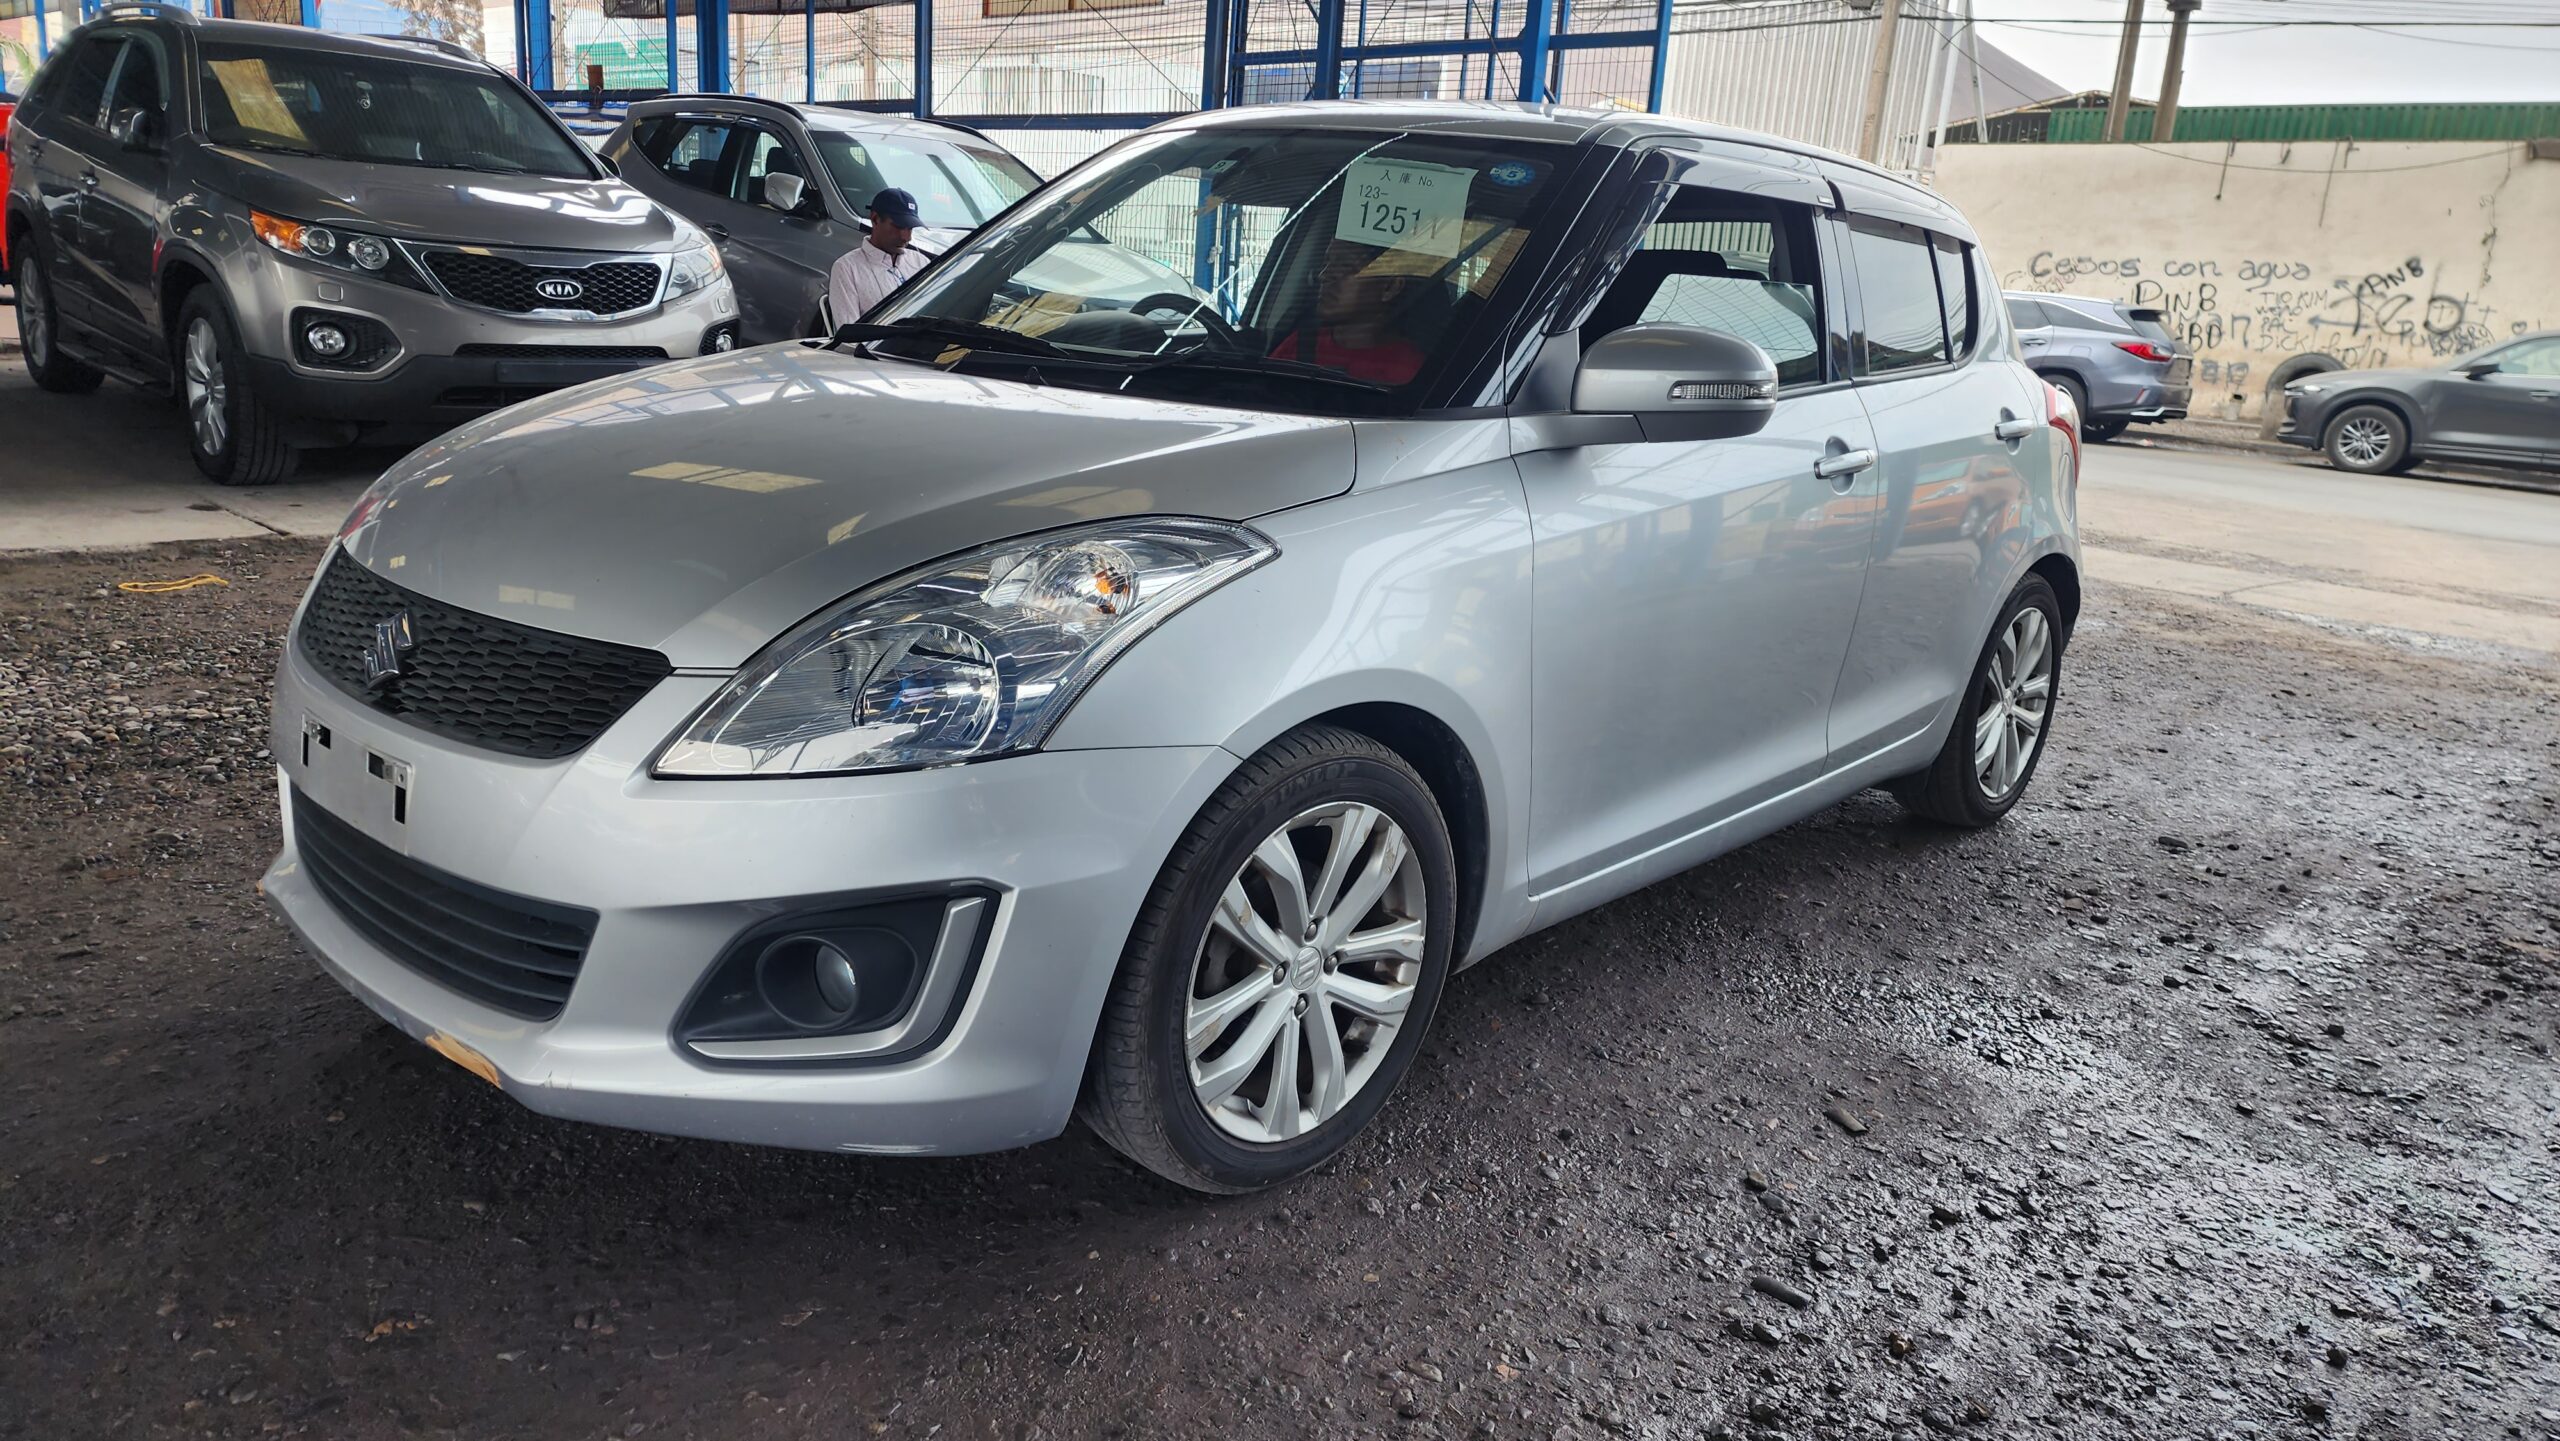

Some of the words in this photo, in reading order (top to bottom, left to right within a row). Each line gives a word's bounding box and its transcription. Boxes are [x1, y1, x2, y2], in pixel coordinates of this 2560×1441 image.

[1418, 176, 1435, 188] No.
[2164, 260, 2223, 278] con
[2238, 260, 2312, 292] agua
[544, 283, 574, 296] KIA
